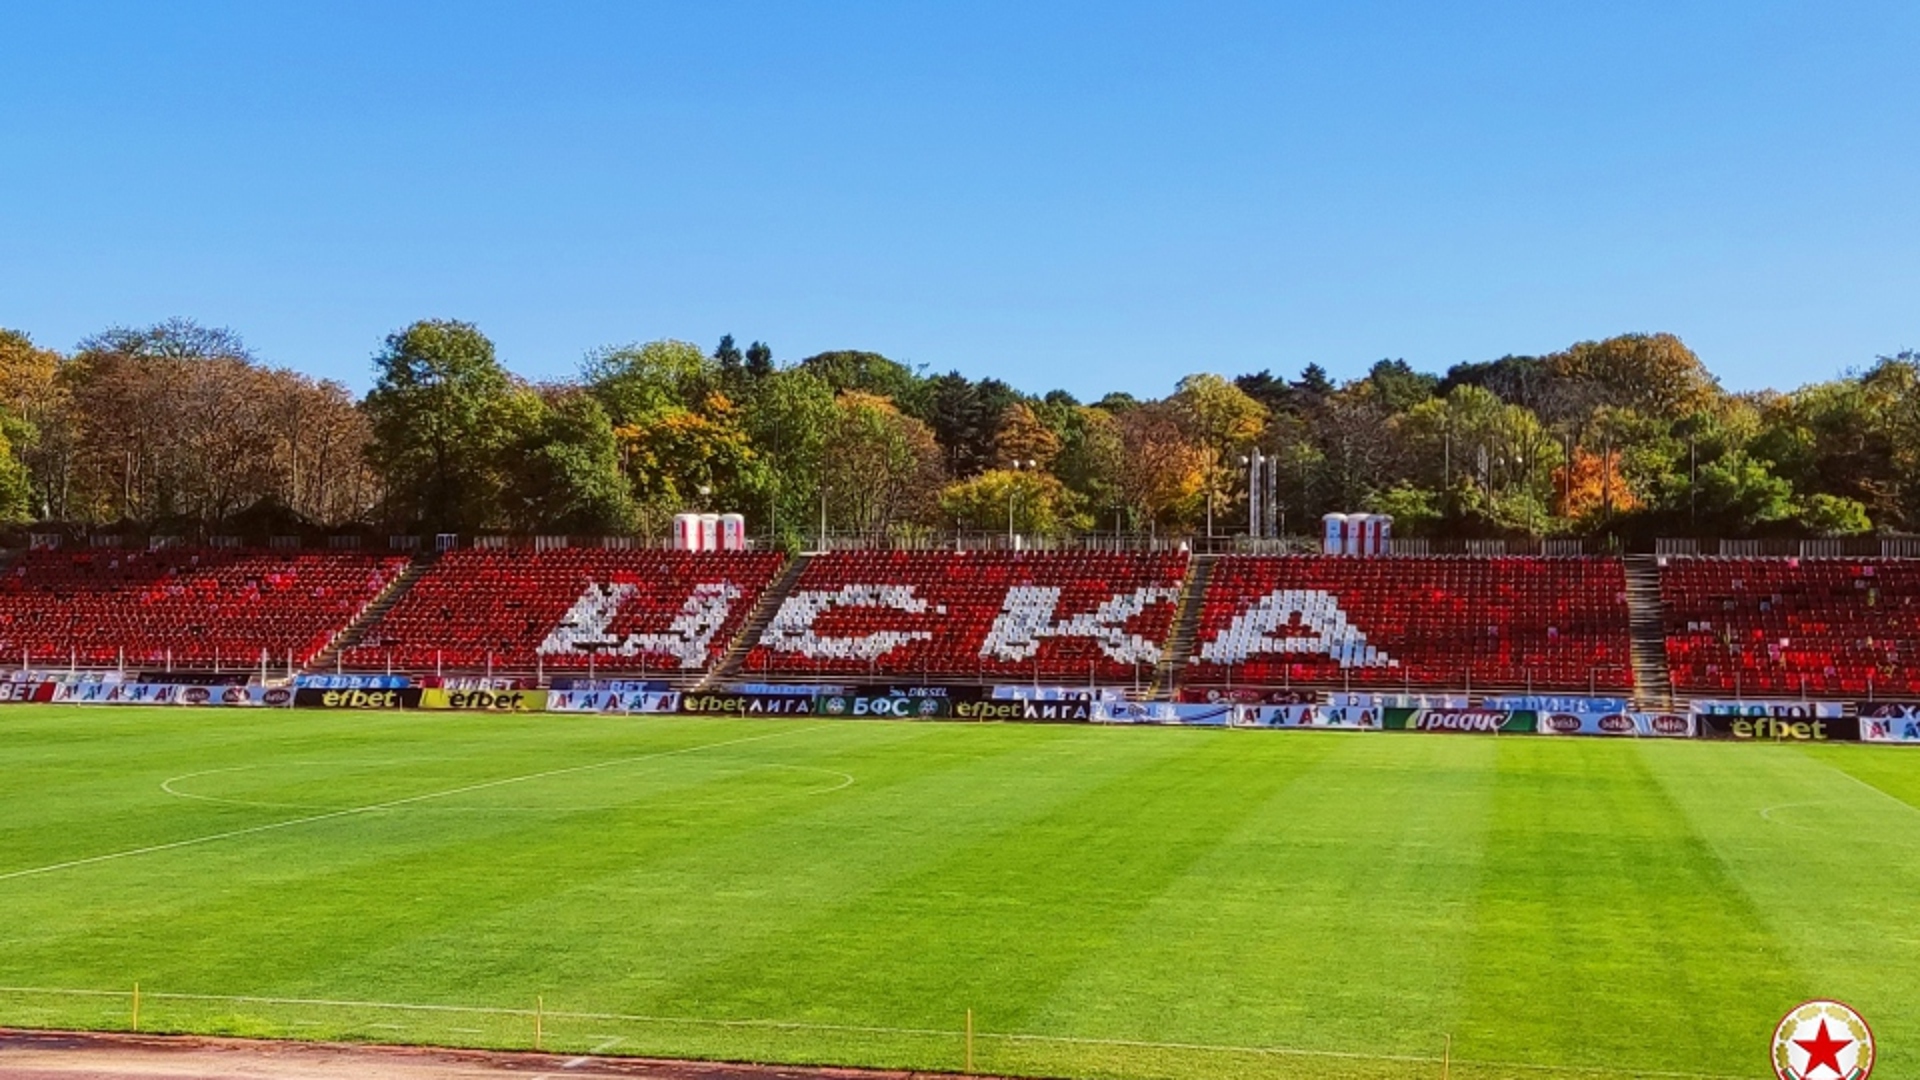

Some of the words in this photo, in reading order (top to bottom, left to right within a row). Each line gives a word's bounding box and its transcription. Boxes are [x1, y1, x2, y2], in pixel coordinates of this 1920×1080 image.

[536, 582, 1399, 669] ЦСКА
[322, 689, 397, 707] efbet
[448, 691, 524, 709] efbet
[554, 692, 574, 708] A1
[579, 692, 599, 709] A1
[603, 693, 624, 710] A1
[629, 693, 649, 710] A1
[656, 694, 675, 710] A1
[684, 696, 746, 711] efbet
[749, 699, 809, 713] ЛИГА
[852, 697, 910, 717] БФС
[957, 701, 1021, 717] efbet
[1023, 705, 1087, 719] ЛИГА
[1243, 707, 1261, 723] A1
[1269, 707, 1290, 724] A1
[1298, 708, 1318, 724] A1
[1328, 708, 1347, 724] A1
[1358, 708, 1378, 726] A1
[1417, 709, 1505, 730] Градус
[1731, 718, 1827, 739] efbet
